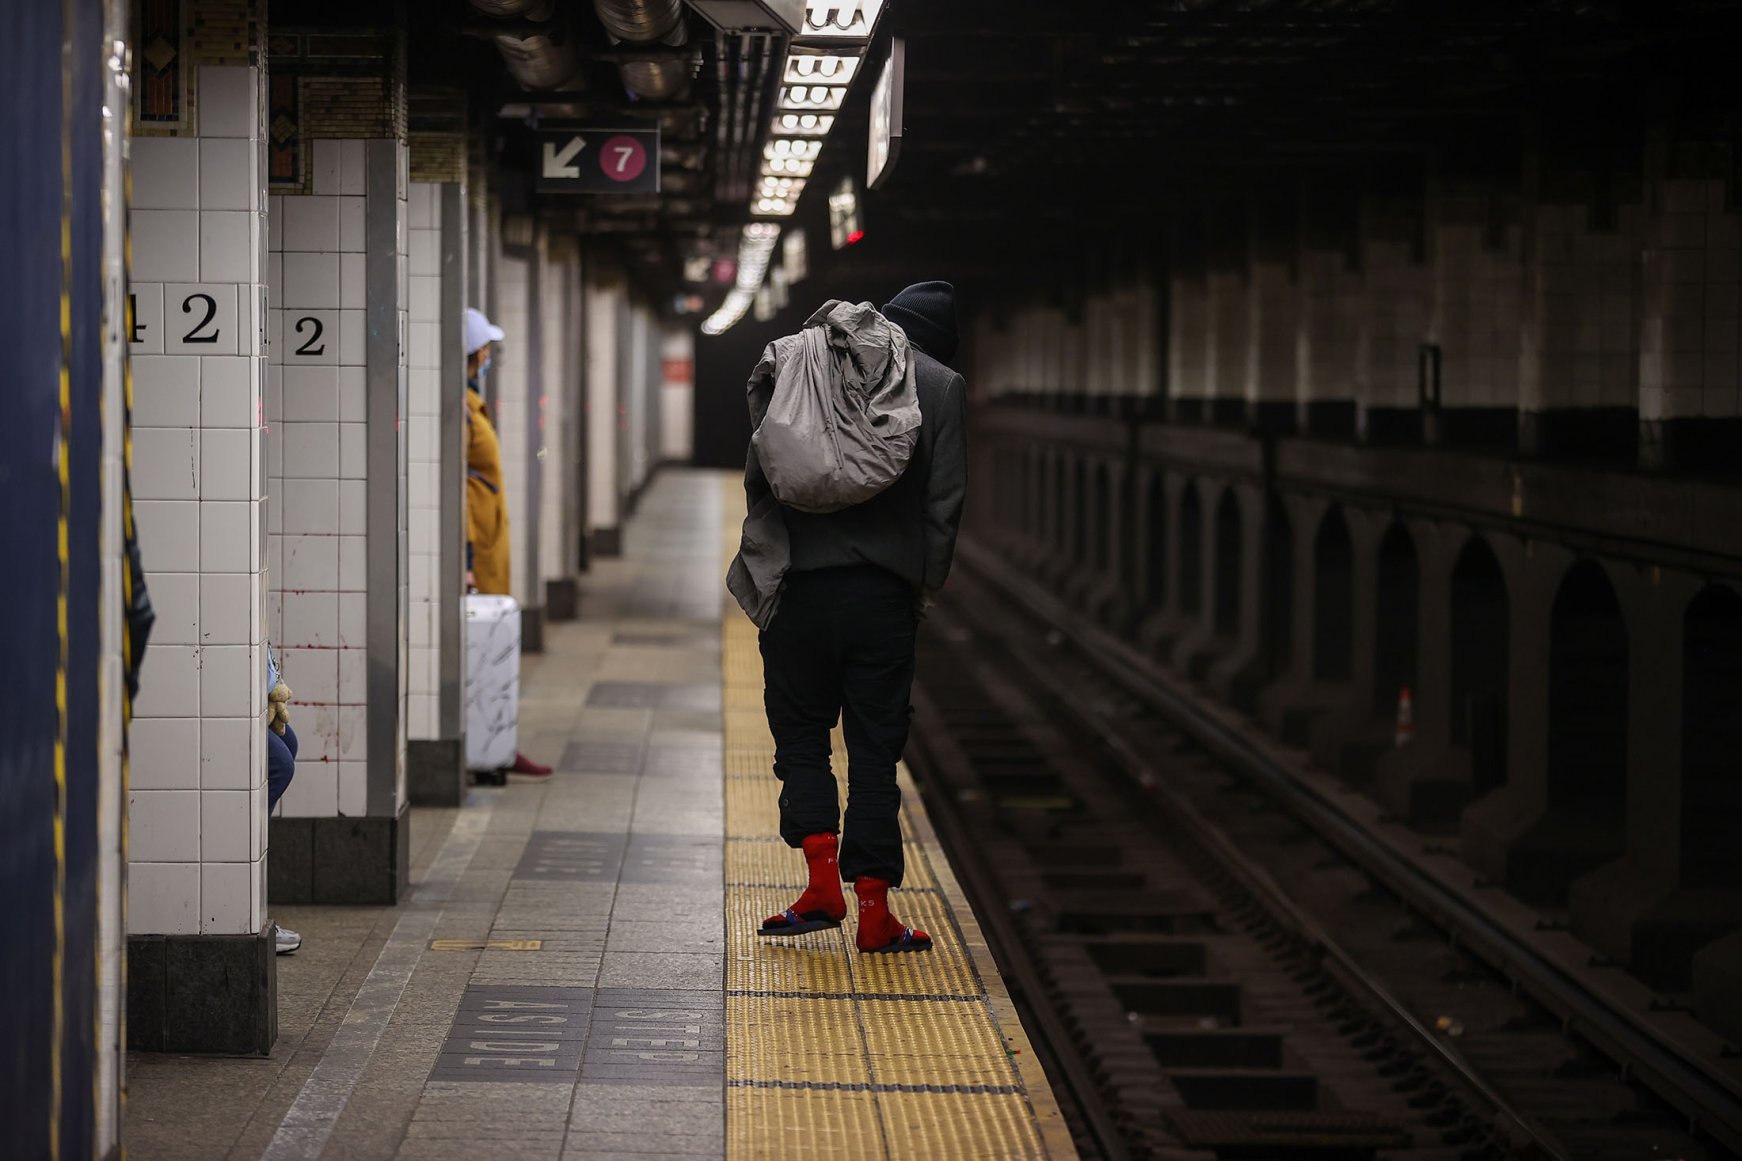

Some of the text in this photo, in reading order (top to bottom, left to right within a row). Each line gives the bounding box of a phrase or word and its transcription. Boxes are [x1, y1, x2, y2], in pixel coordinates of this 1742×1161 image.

[613, 146, 634, 173] 7
[294, 316, 326, 356] 2
[464, 1000, 569, 1067] ASIDE
[609, 1010, 705, 1062] STEP
